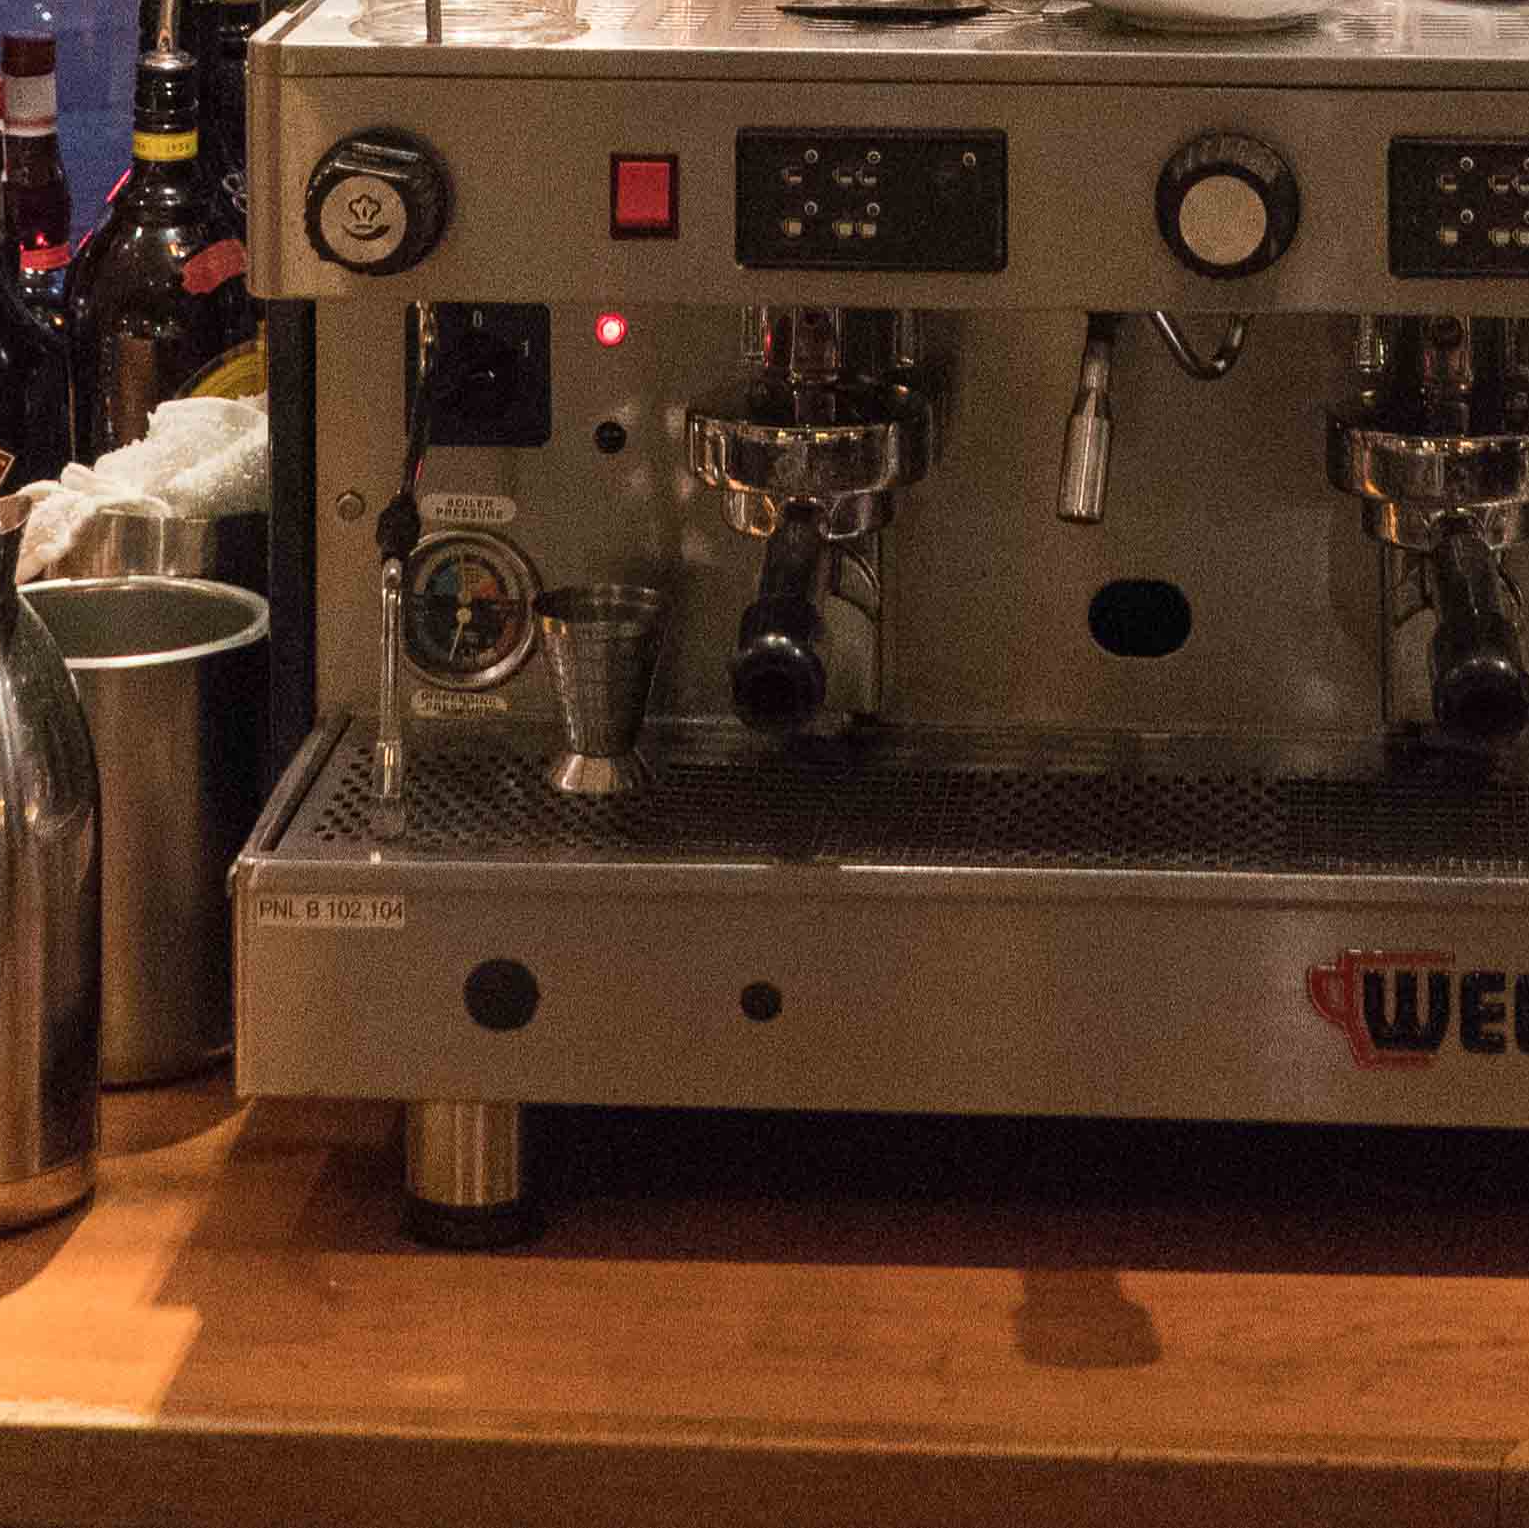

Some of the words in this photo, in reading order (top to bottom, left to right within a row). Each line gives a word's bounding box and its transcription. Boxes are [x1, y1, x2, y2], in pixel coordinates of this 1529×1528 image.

[258, 900, 296, 919] PNL
[328, 901, 361, 919] 102
[370, 900, 404, 919] 104
